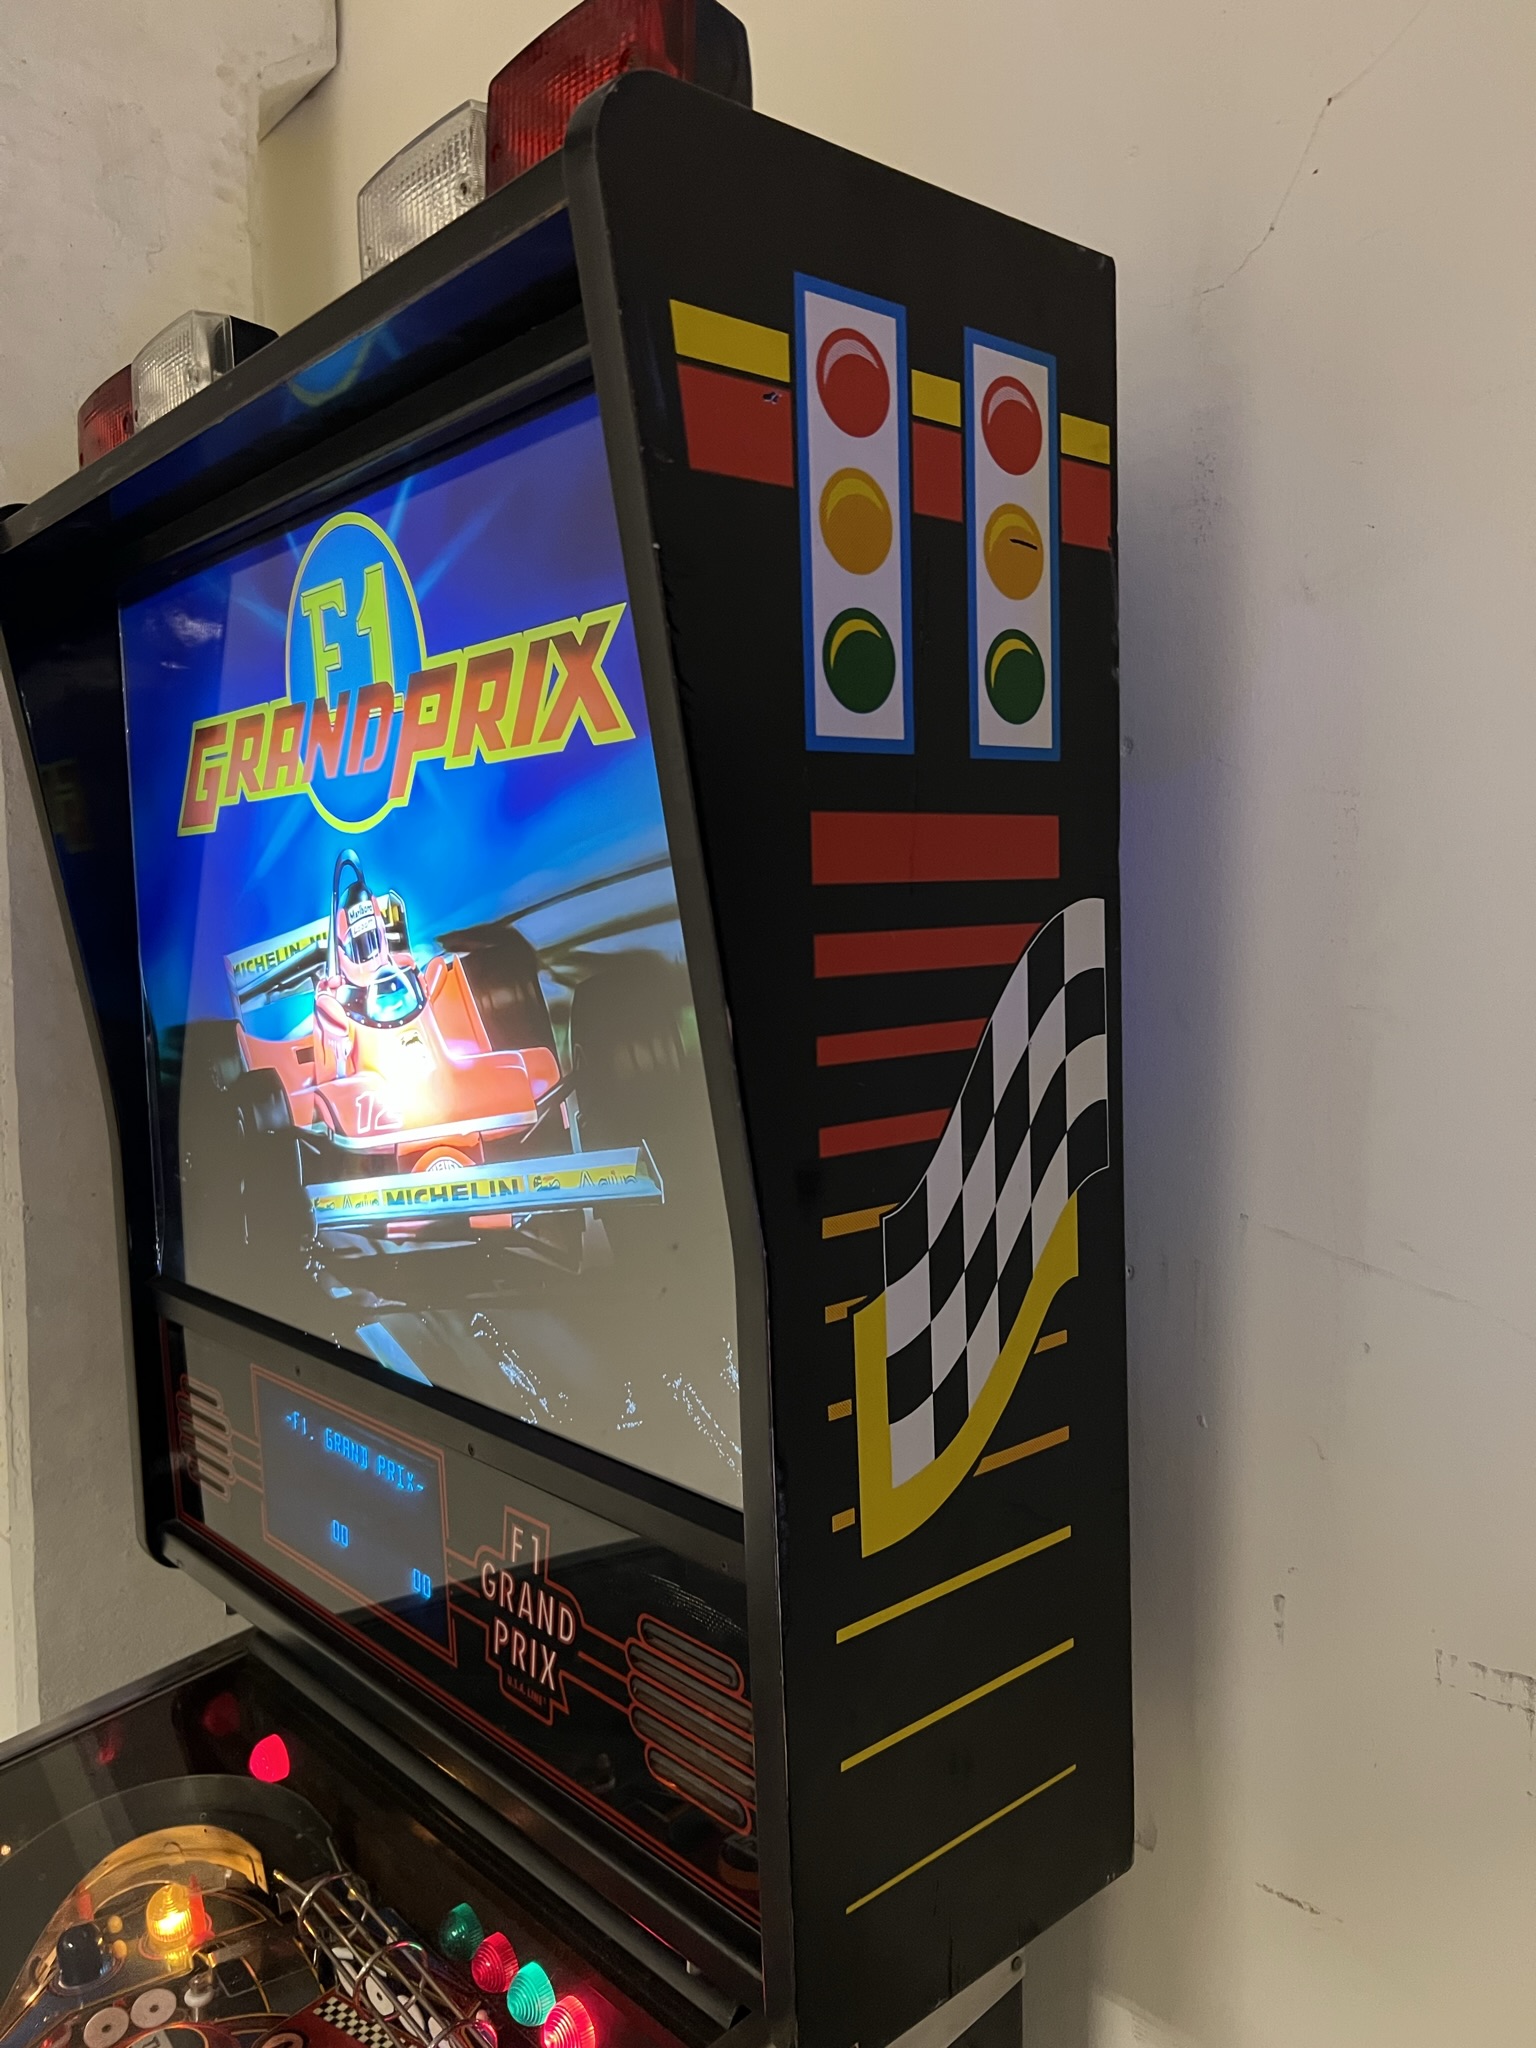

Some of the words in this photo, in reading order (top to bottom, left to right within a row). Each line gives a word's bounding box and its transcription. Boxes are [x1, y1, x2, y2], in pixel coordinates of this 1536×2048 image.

[301, 562, 404, 724] F1
[178, 680, 397, 835] GRAND
[388, 603, 634, 806] PRIX
[233, 942, 301, 977] MICHELIN
[386, 1178, 519, 1207] MICHELIN
[324, 1427, 368, 1470] GRAND
[332, 1519, 349, 1548] 00
[511, 1523, 541, 1576] F1
[412, 1567, 431, 1599] 00
[481, 1560, 576, 1645] GRAND
[494, 1616, 557, 1692] PRIX
